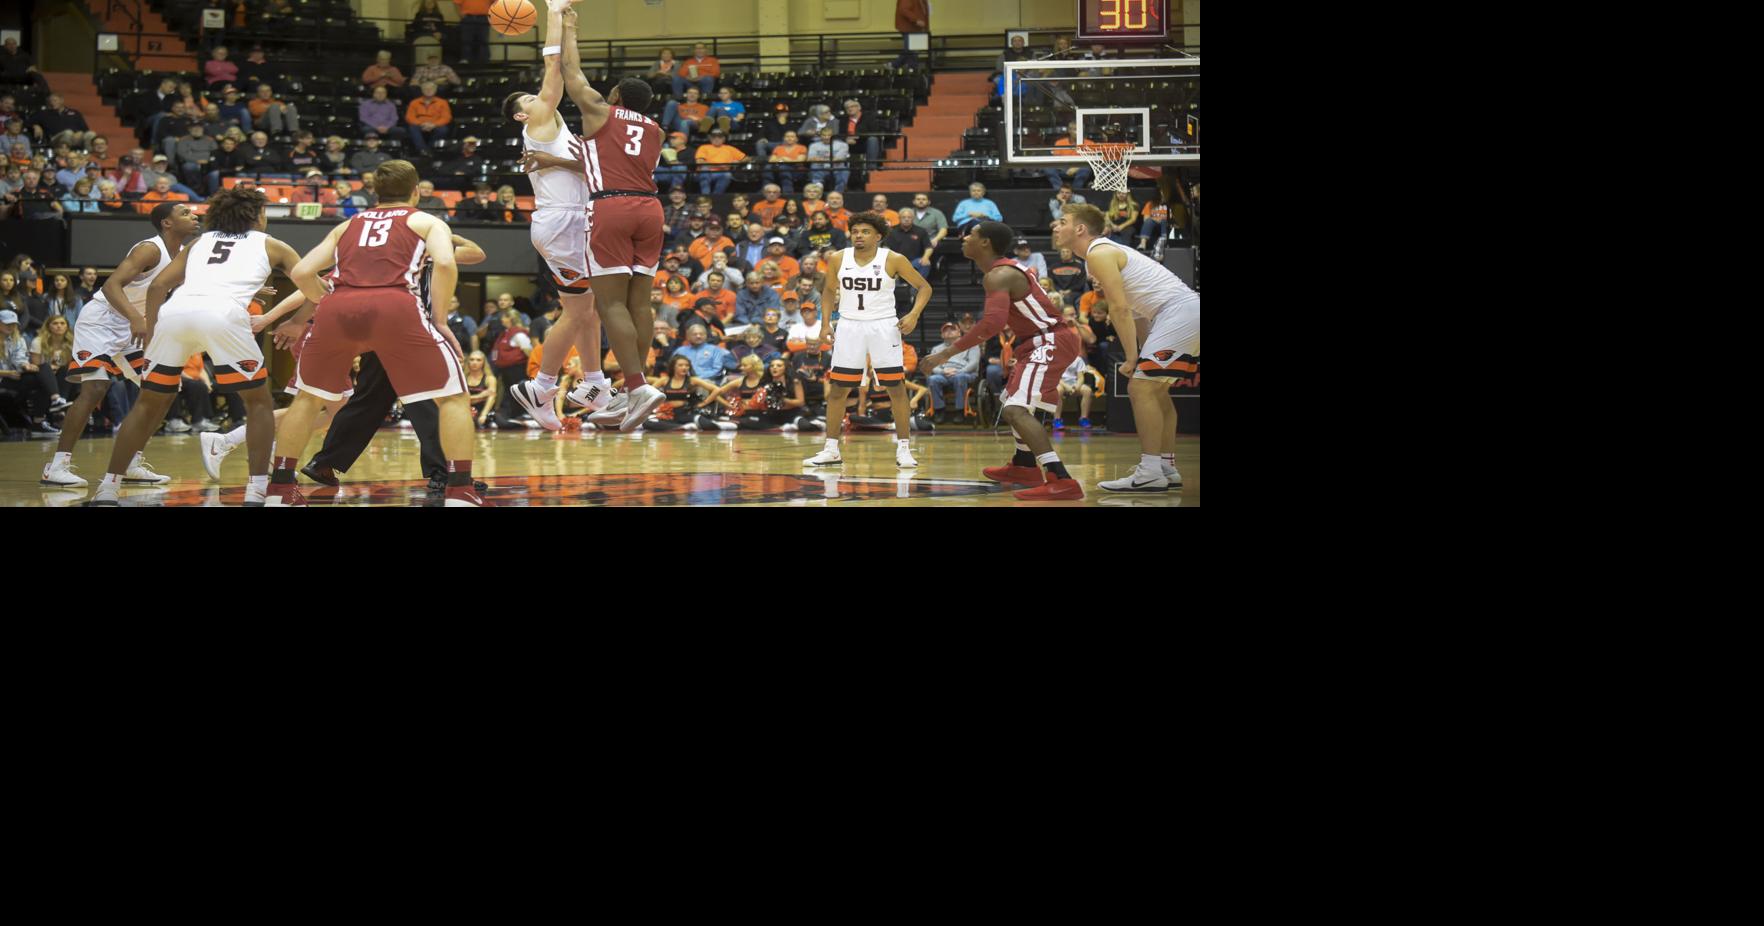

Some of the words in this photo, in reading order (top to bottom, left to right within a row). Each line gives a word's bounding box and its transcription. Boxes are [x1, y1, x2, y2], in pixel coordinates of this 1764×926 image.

[615, 108, 643, 122] FRANKS
[624, 124, 645, 157] 3
[301, 205, 320, 217] EXIT
[357, 209, 409, 220] POLLARD
[358, 218, 393, 248] 13
[207, 240, 236, 265] 5
[842, 276, 883, 291] OSU
[857, 293, 865, 311] 1
[584, 384, 601, 404] NIKE
